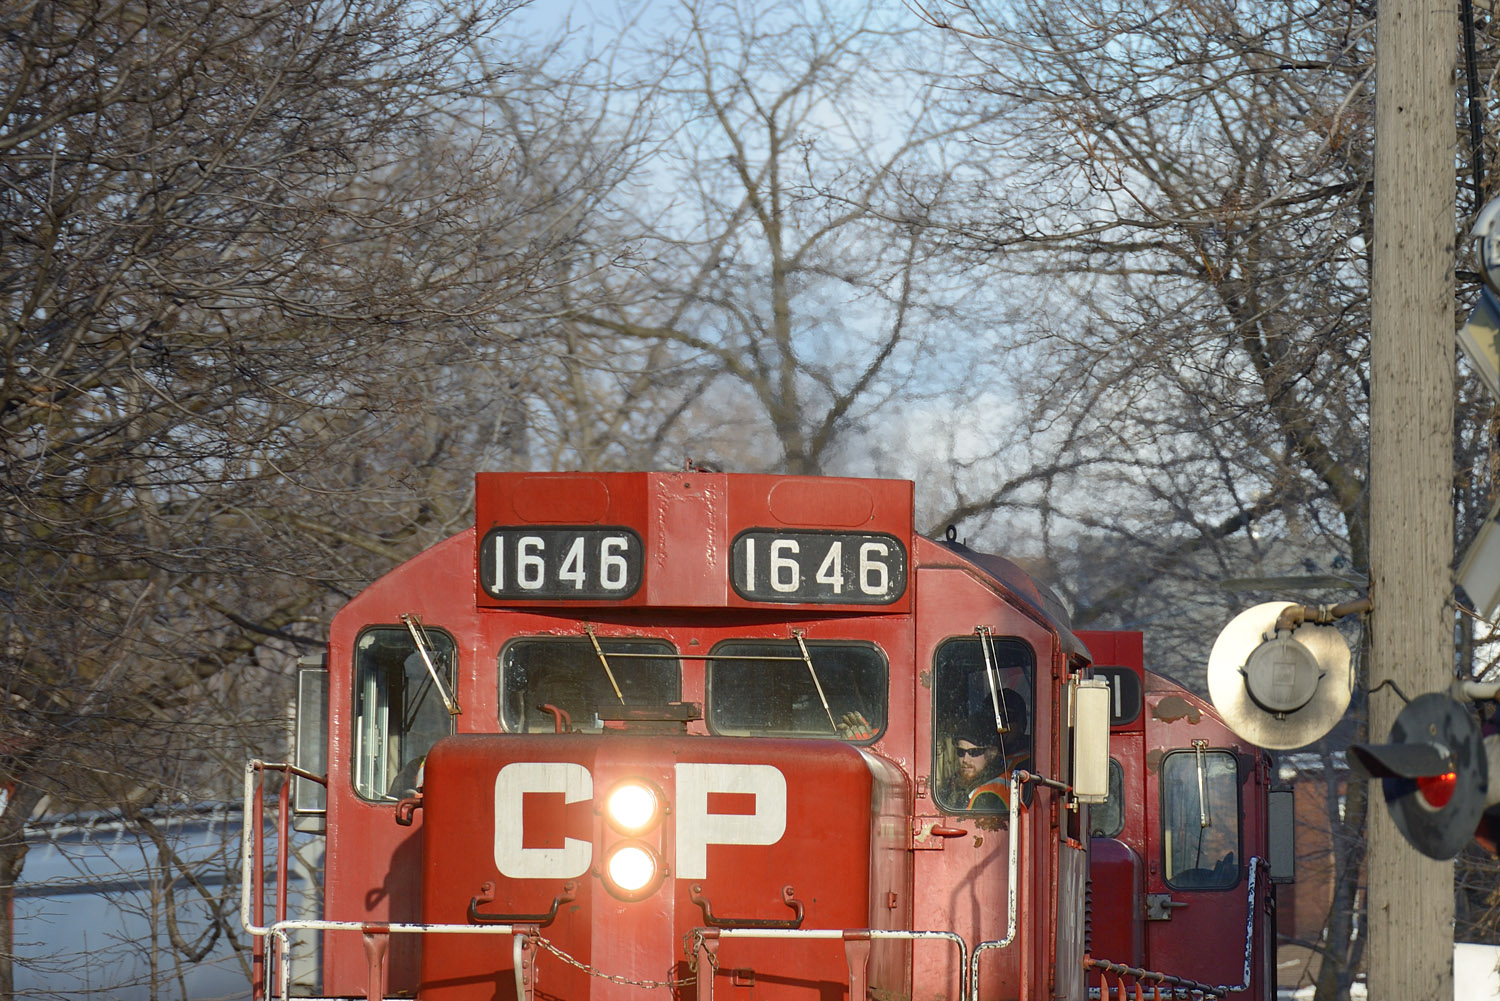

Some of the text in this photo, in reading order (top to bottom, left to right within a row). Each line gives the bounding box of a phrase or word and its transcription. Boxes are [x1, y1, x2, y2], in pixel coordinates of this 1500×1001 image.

[491, 536, 629, 591] 1646
[745, 538, 889, 596] 1646
[493, 762, 788, 880] CP
